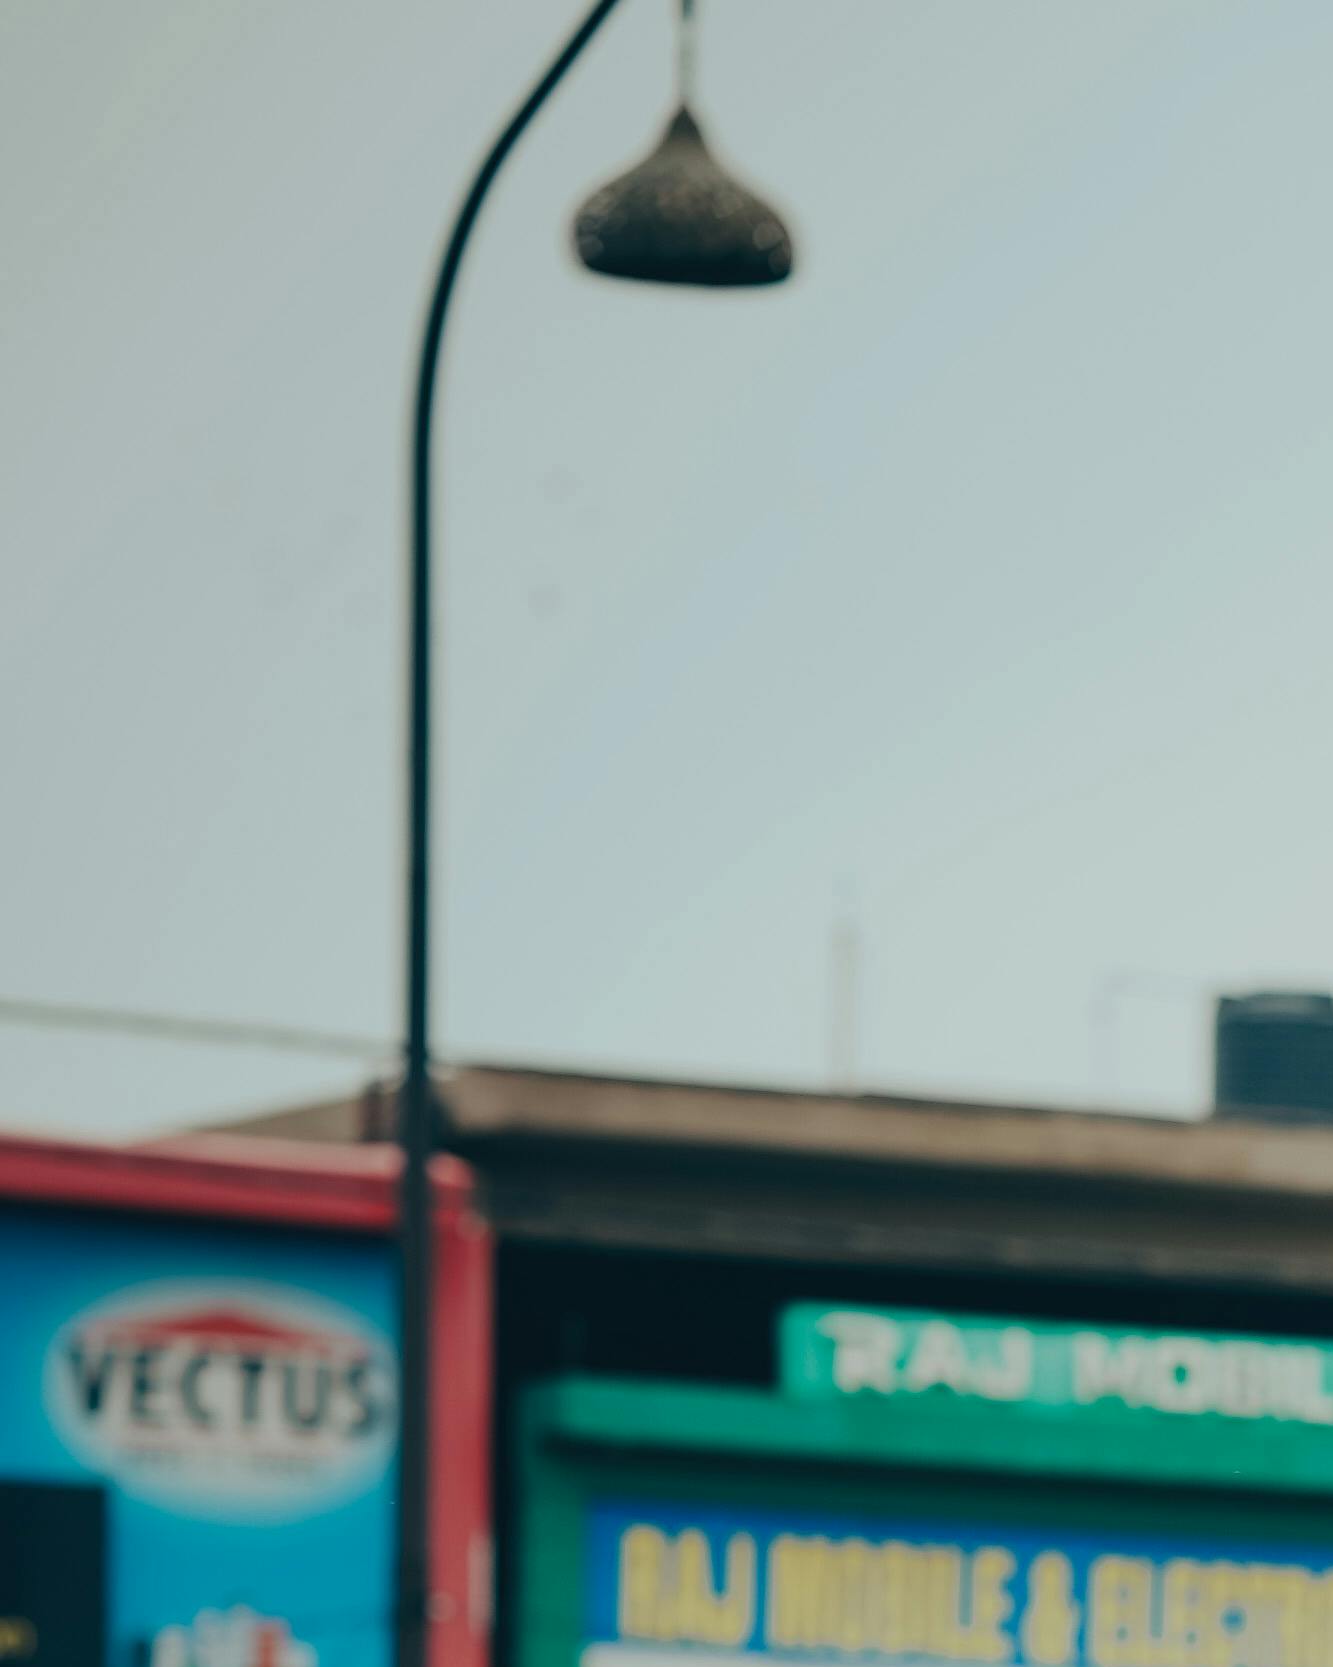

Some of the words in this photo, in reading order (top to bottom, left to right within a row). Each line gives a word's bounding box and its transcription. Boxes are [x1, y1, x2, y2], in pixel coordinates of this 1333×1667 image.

[66, 1338, 385, 1442] VECTUS
[821, 1311, 1033, 1402] RAJ
[618, 1523, 756, 1646] RAJ
[767, 1534, 1014, 1664] MOBILE
[1025, 1550, 1077, 1667] &
